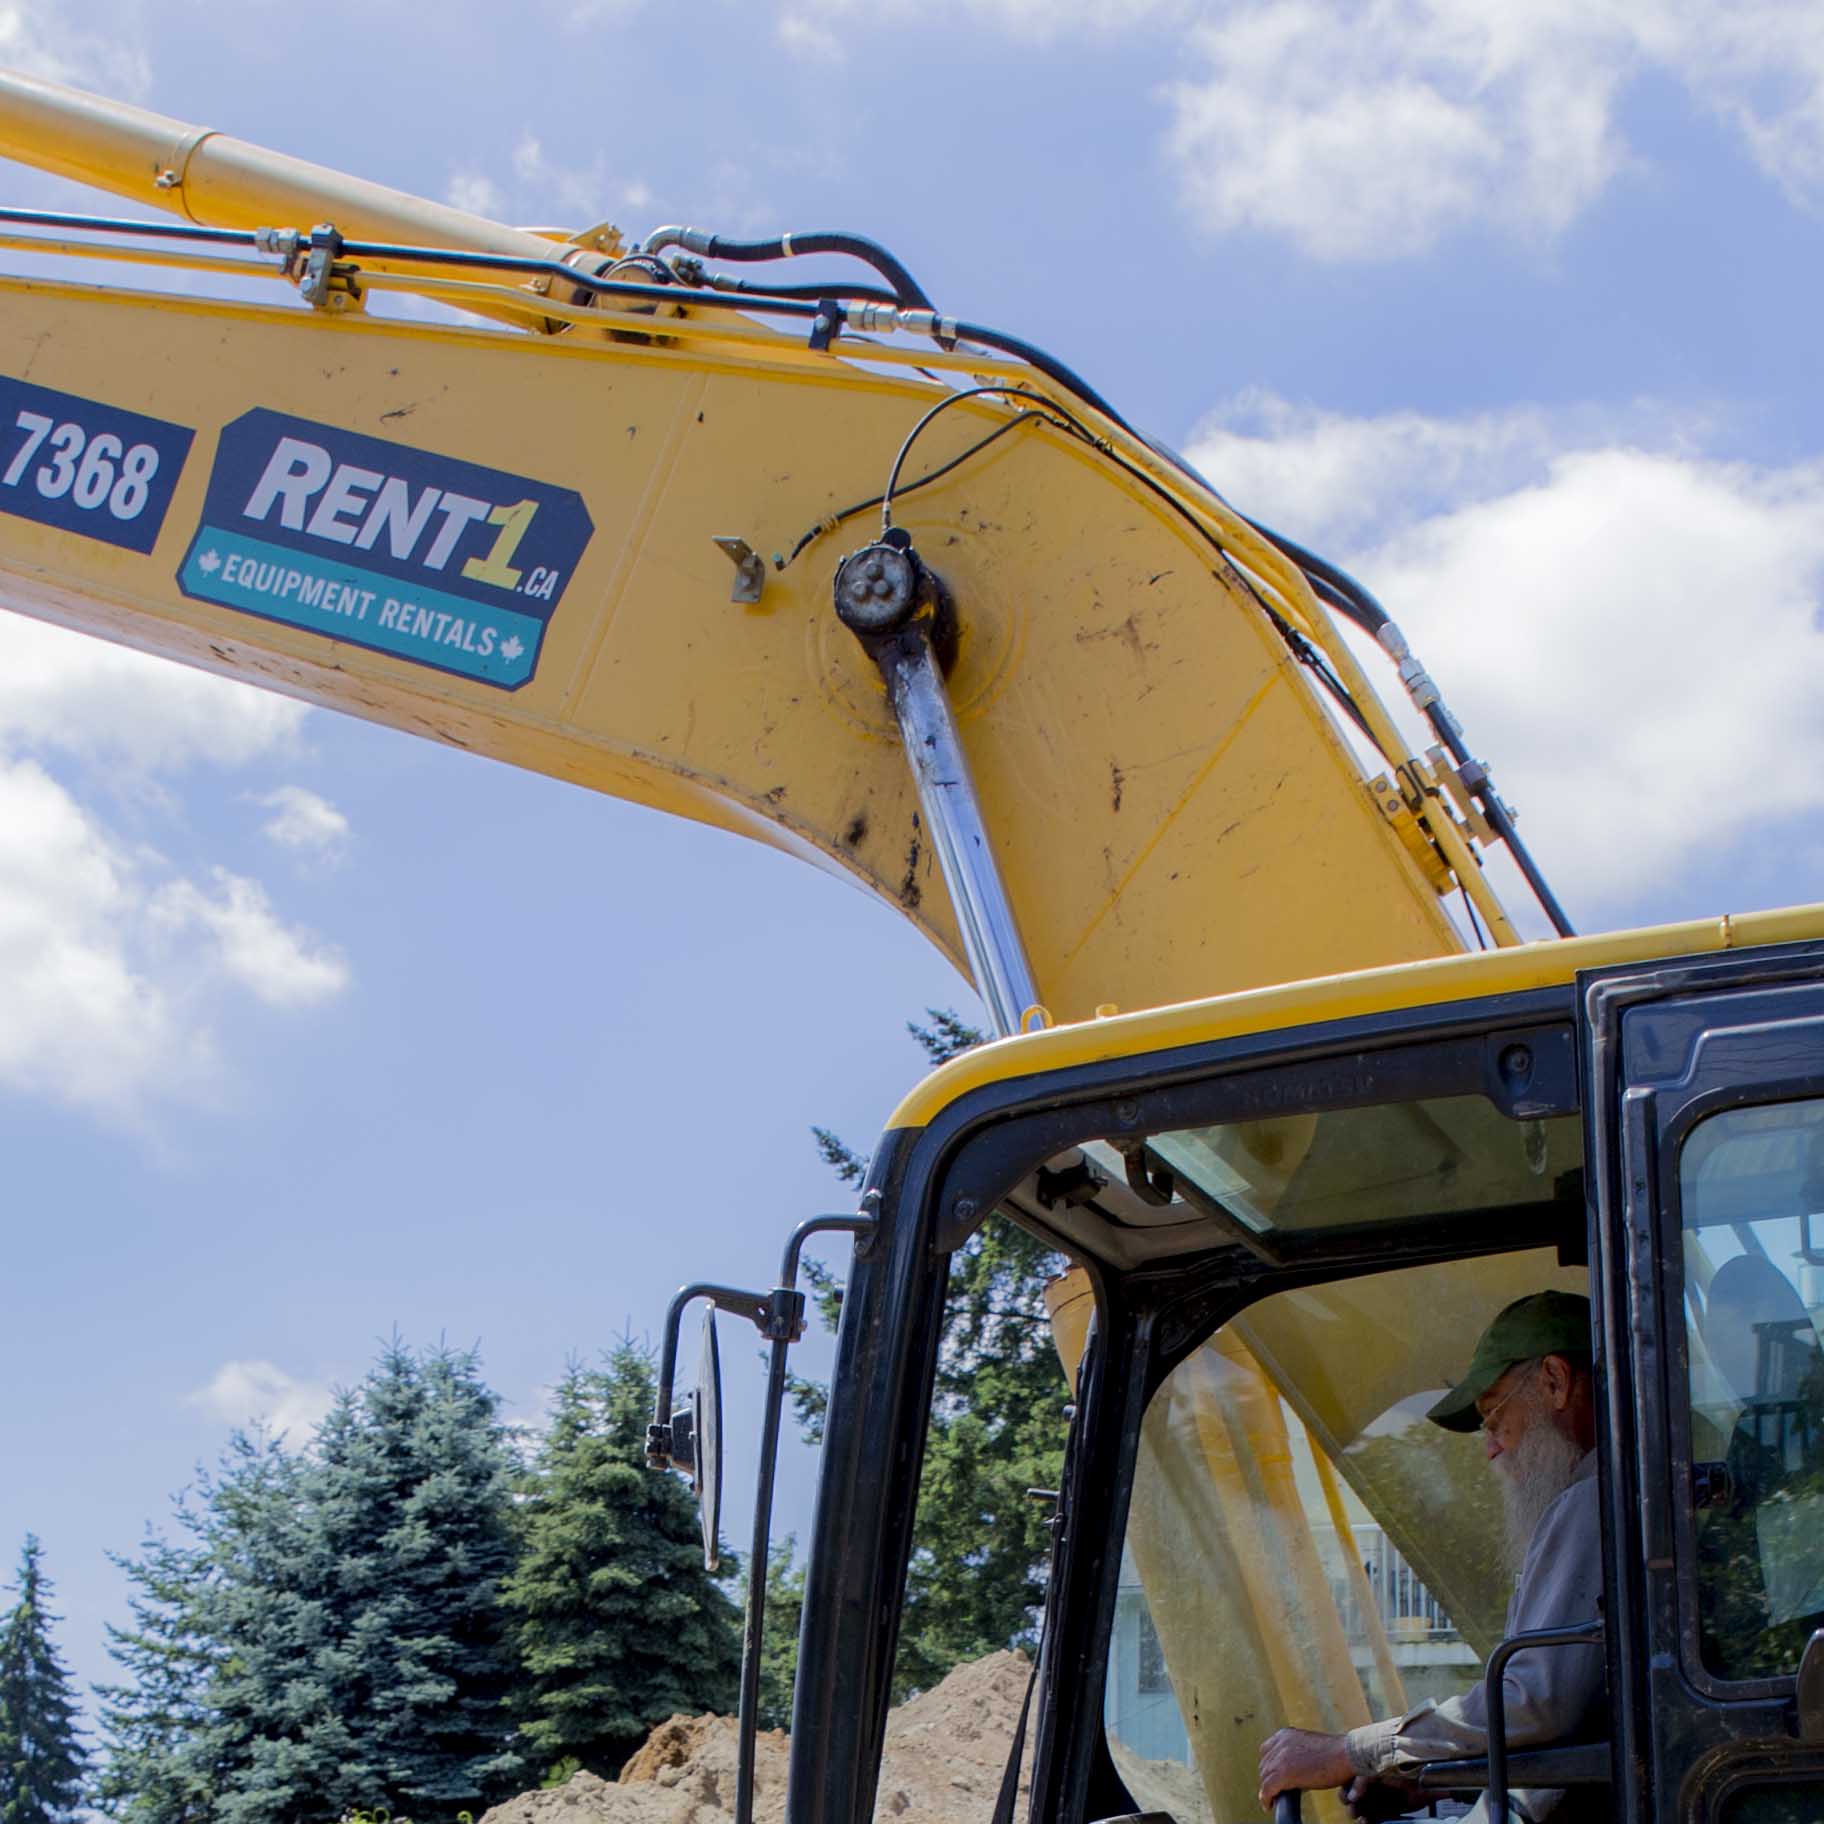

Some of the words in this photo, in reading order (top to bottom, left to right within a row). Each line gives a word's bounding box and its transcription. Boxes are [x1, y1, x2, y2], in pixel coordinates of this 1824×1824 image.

[2, 410, 160, 521] 7368
[221, 552, 378, 621] EQUIPMENT
[378, 598, 498, 658] RENTALS
